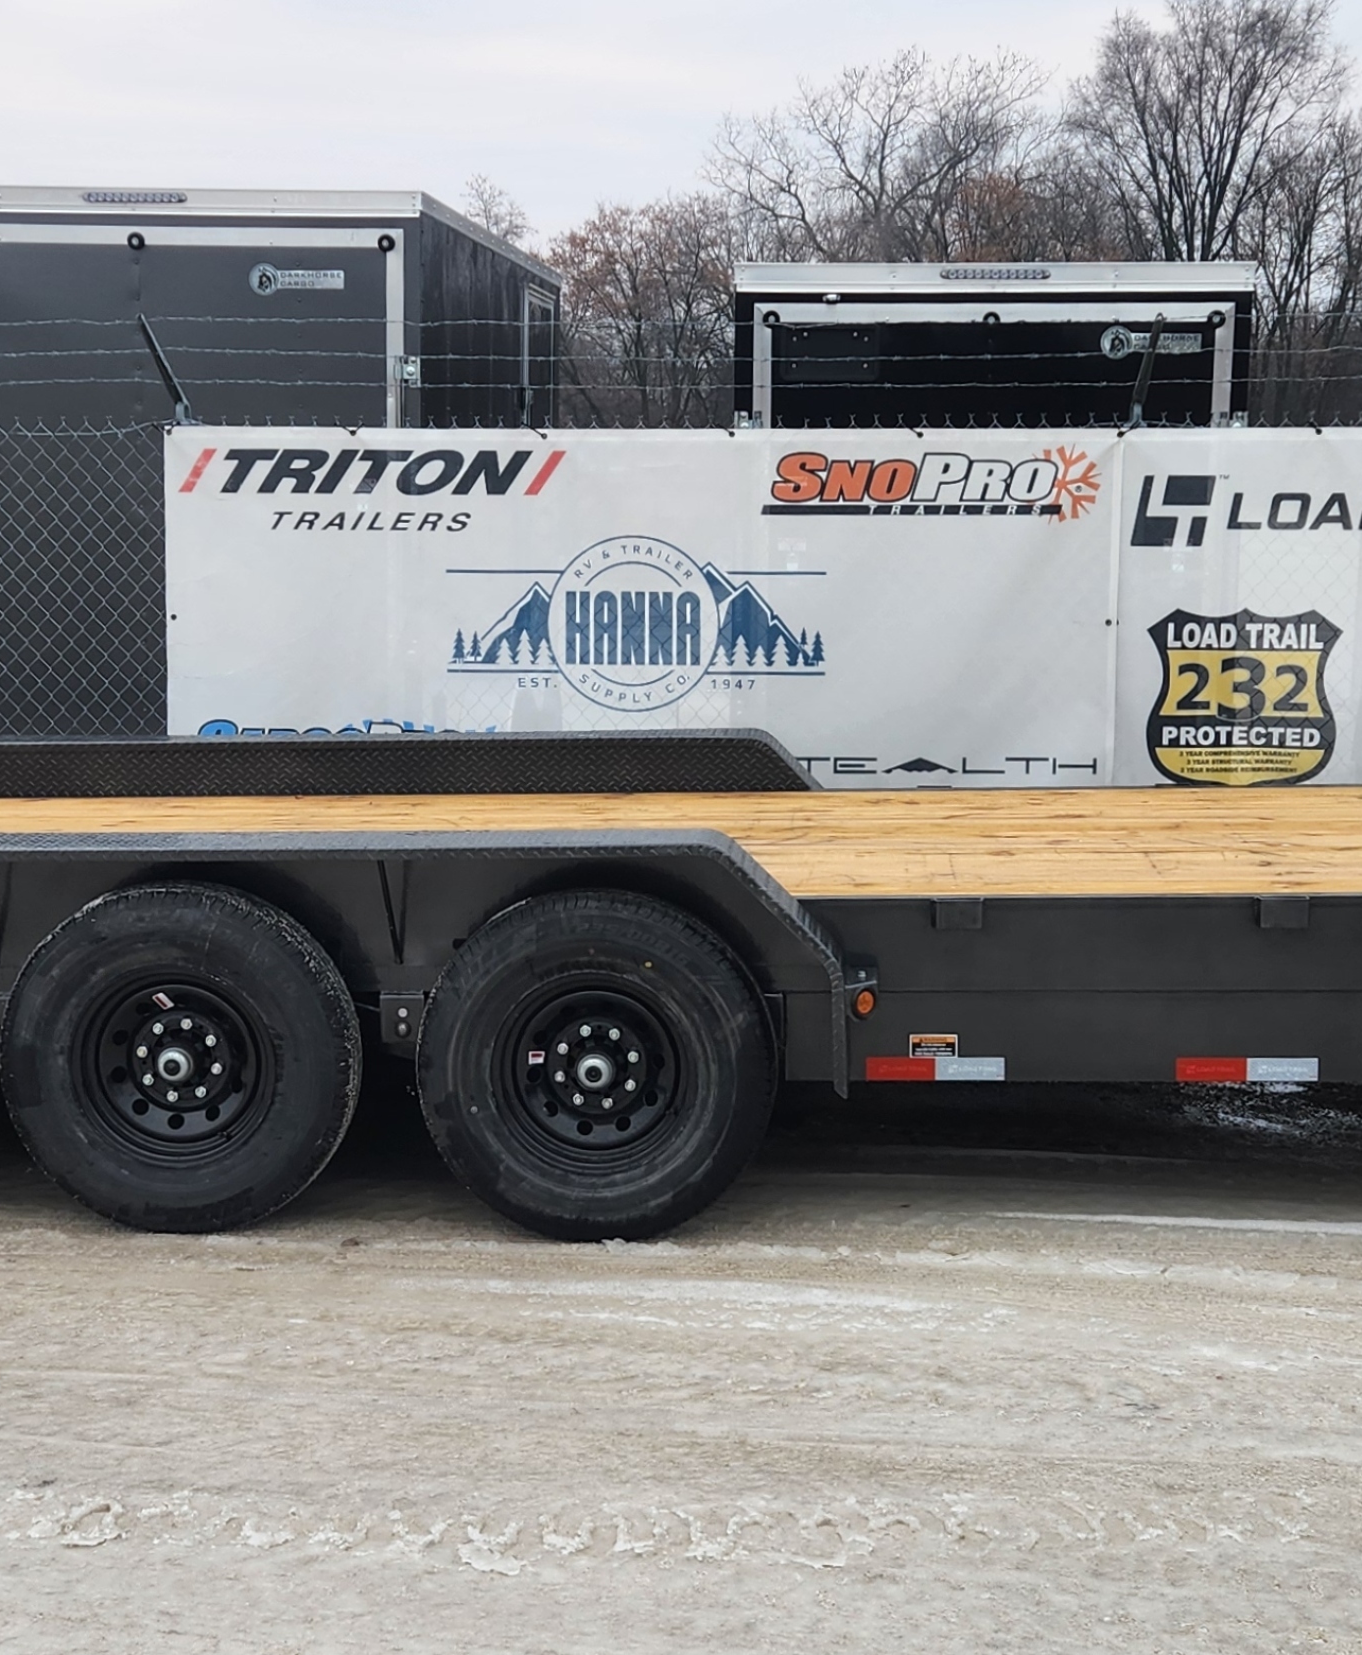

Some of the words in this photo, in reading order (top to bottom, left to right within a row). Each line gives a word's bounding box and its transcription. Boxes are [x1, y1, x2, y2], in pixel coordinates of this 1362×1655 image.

[220, 448, 533, 496] TRITON
[270, 511, 472, 532] TRAILERS
[868, 504, 1043, 516] TRAILERS
[574, 559, 593, 579] RV
[601, 549, 611, 559] &
[620, 544, 694, 580] TRAILER
[565, 590, 701, 666] HANNA
[1167, 622, 1237, 649] LOAD
[1245, 622, 1324, 650] TRAIL
[517, 676, 558, 689] EST.
[578, 673, 653, 704] SUPPLY
[665, 674, 691, 694] CO.
[710, 678, 756, 691] 1947
[1176, 656, 1310, 722] 232
[1162, 726, 1321, 747] PROTECTED
[794, 756, 1098, 775] TEALTH
